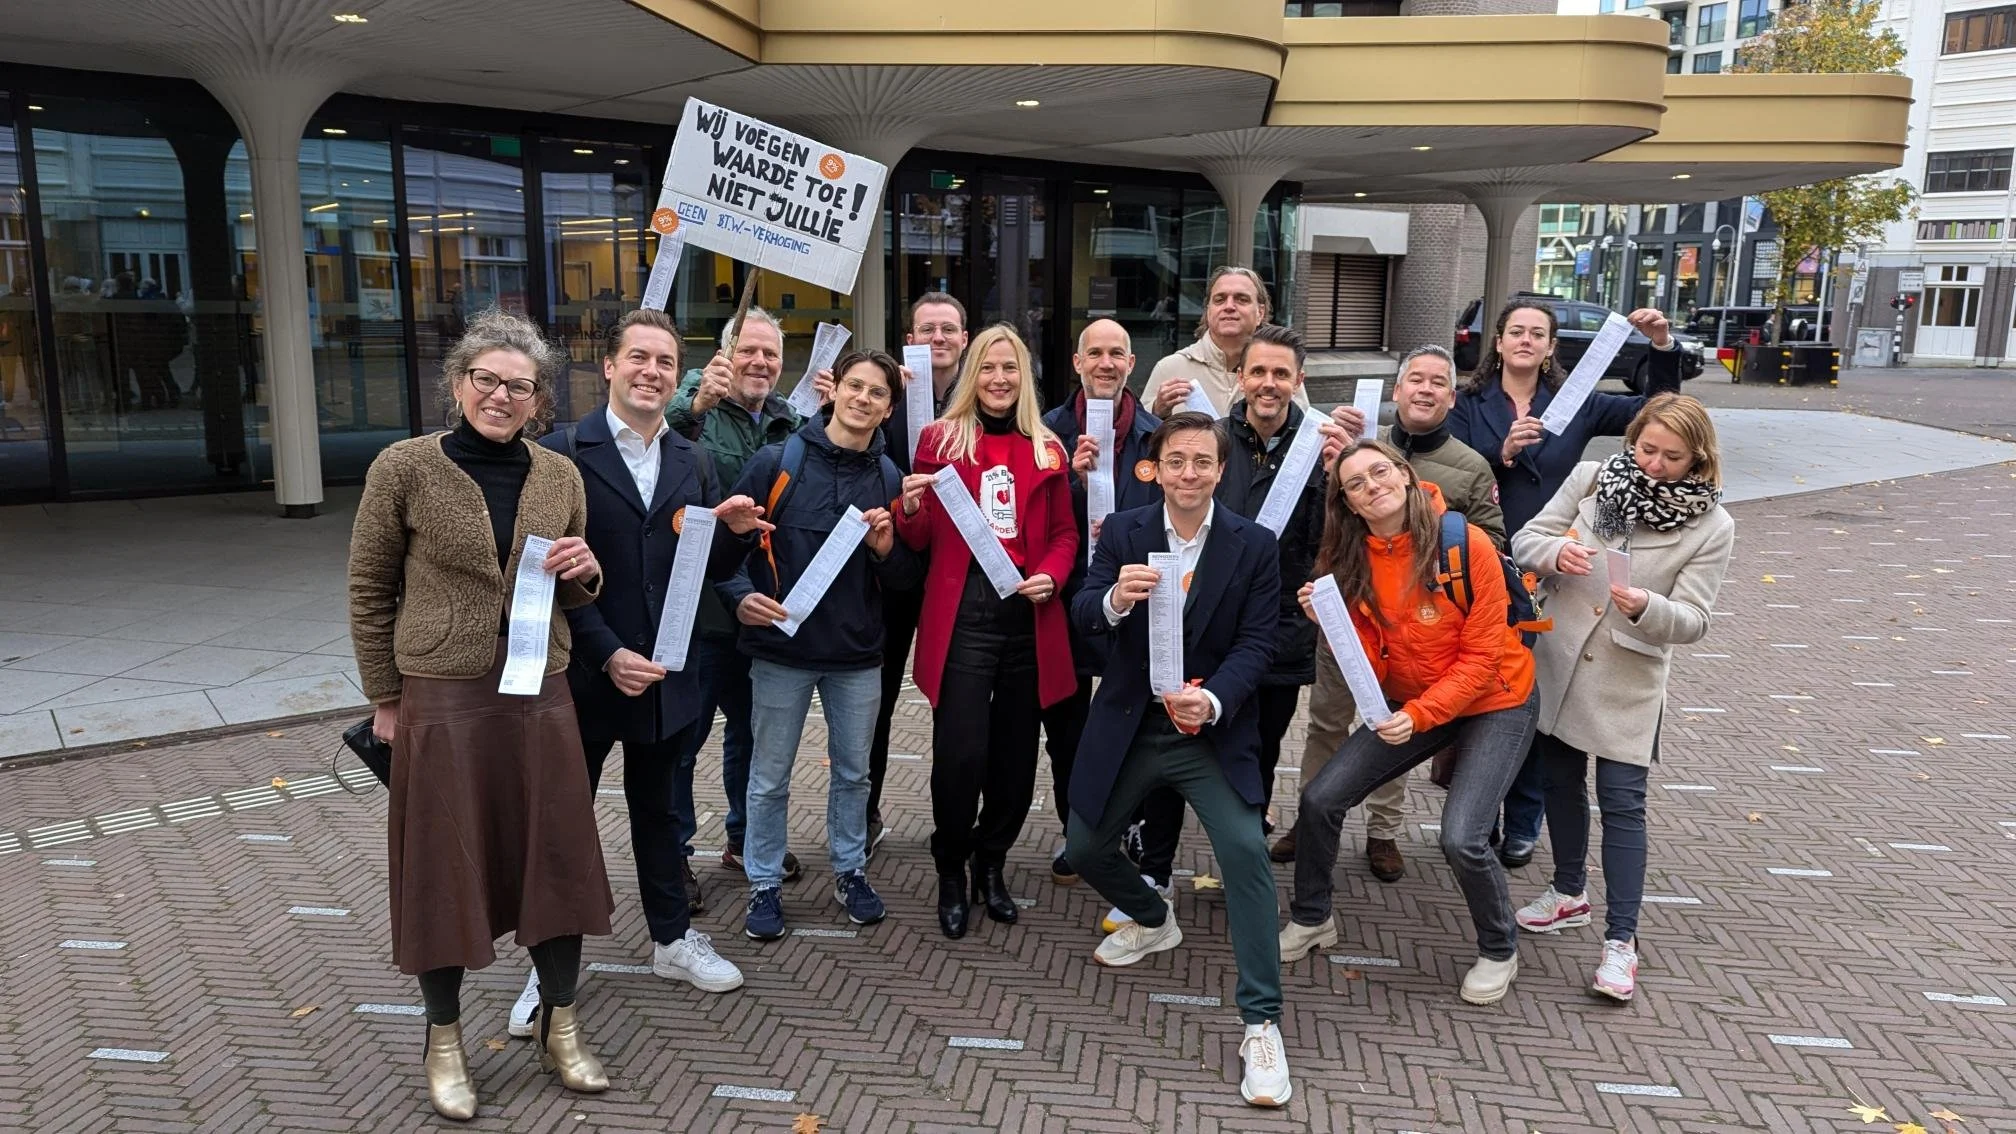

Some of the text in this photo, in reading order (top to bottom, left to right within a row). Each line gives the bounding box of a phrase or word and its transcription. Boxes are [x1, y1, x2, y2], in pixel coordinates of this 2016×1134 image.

[713, 141, 798, 190] WAARDE
[735, 121, 810, 168] VOEGEN
[677, 201, 708, 222] GEEN
